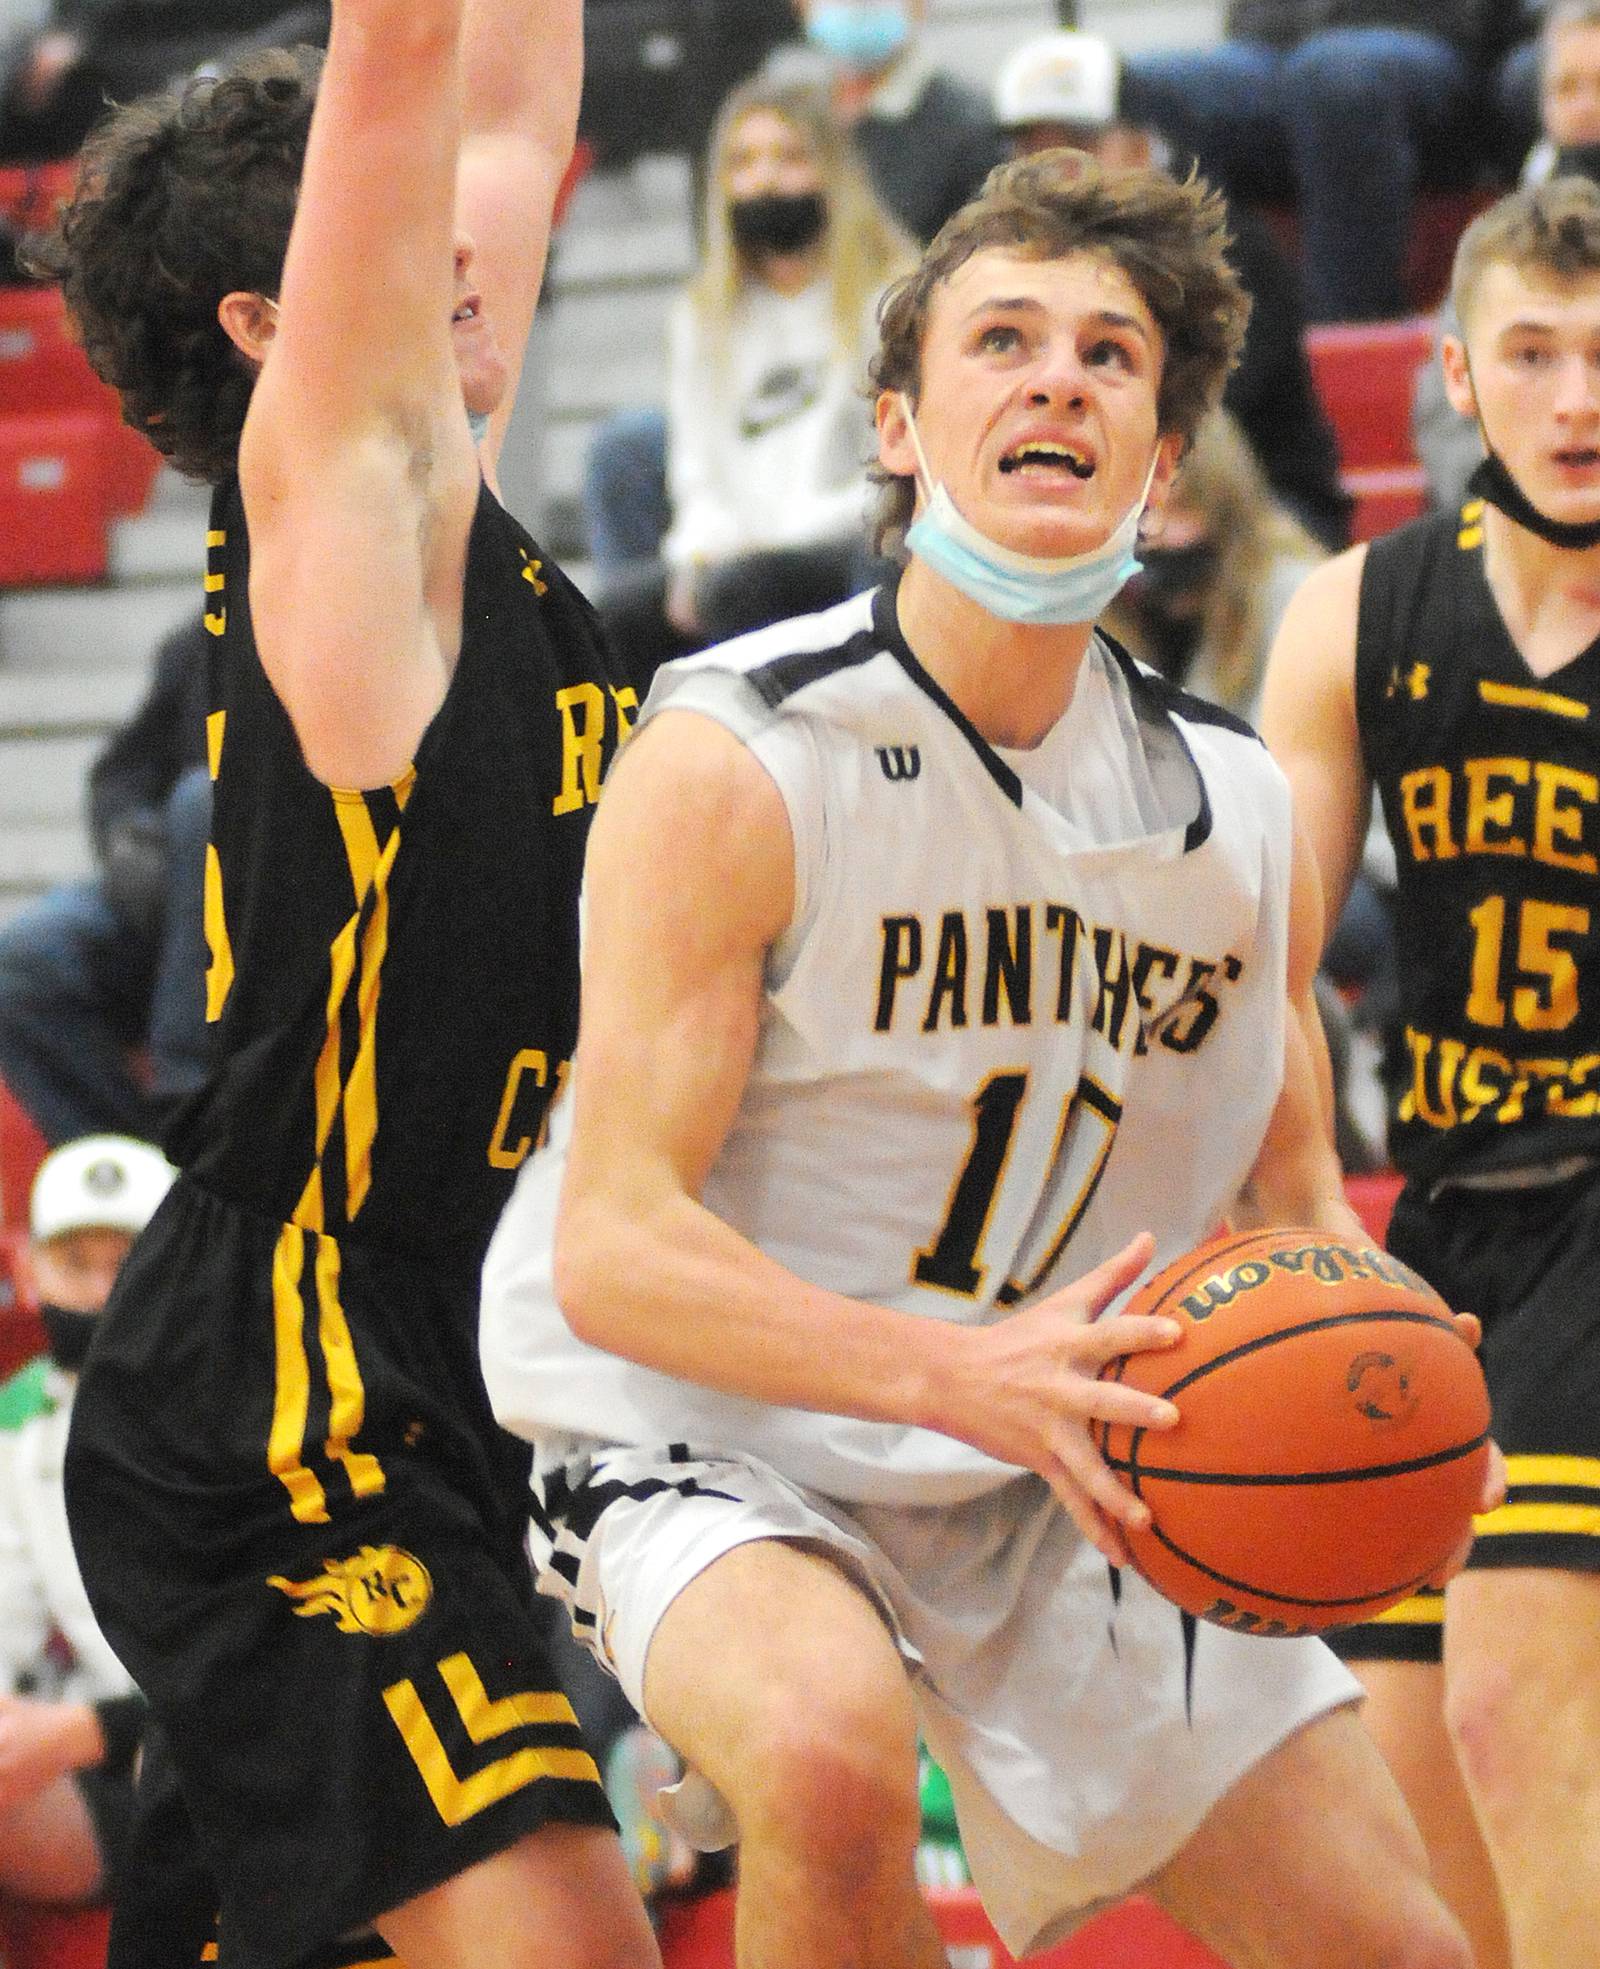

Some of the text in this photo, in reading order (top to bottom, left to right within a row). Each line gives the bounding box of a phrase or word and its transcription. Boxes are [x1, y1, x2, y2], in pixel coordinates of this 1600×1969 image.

[873, 903, 1243, 1056] PANTHES
[1466, 896, 1590, 1031] 15
[911, 1068, 1123, 1309] 10
